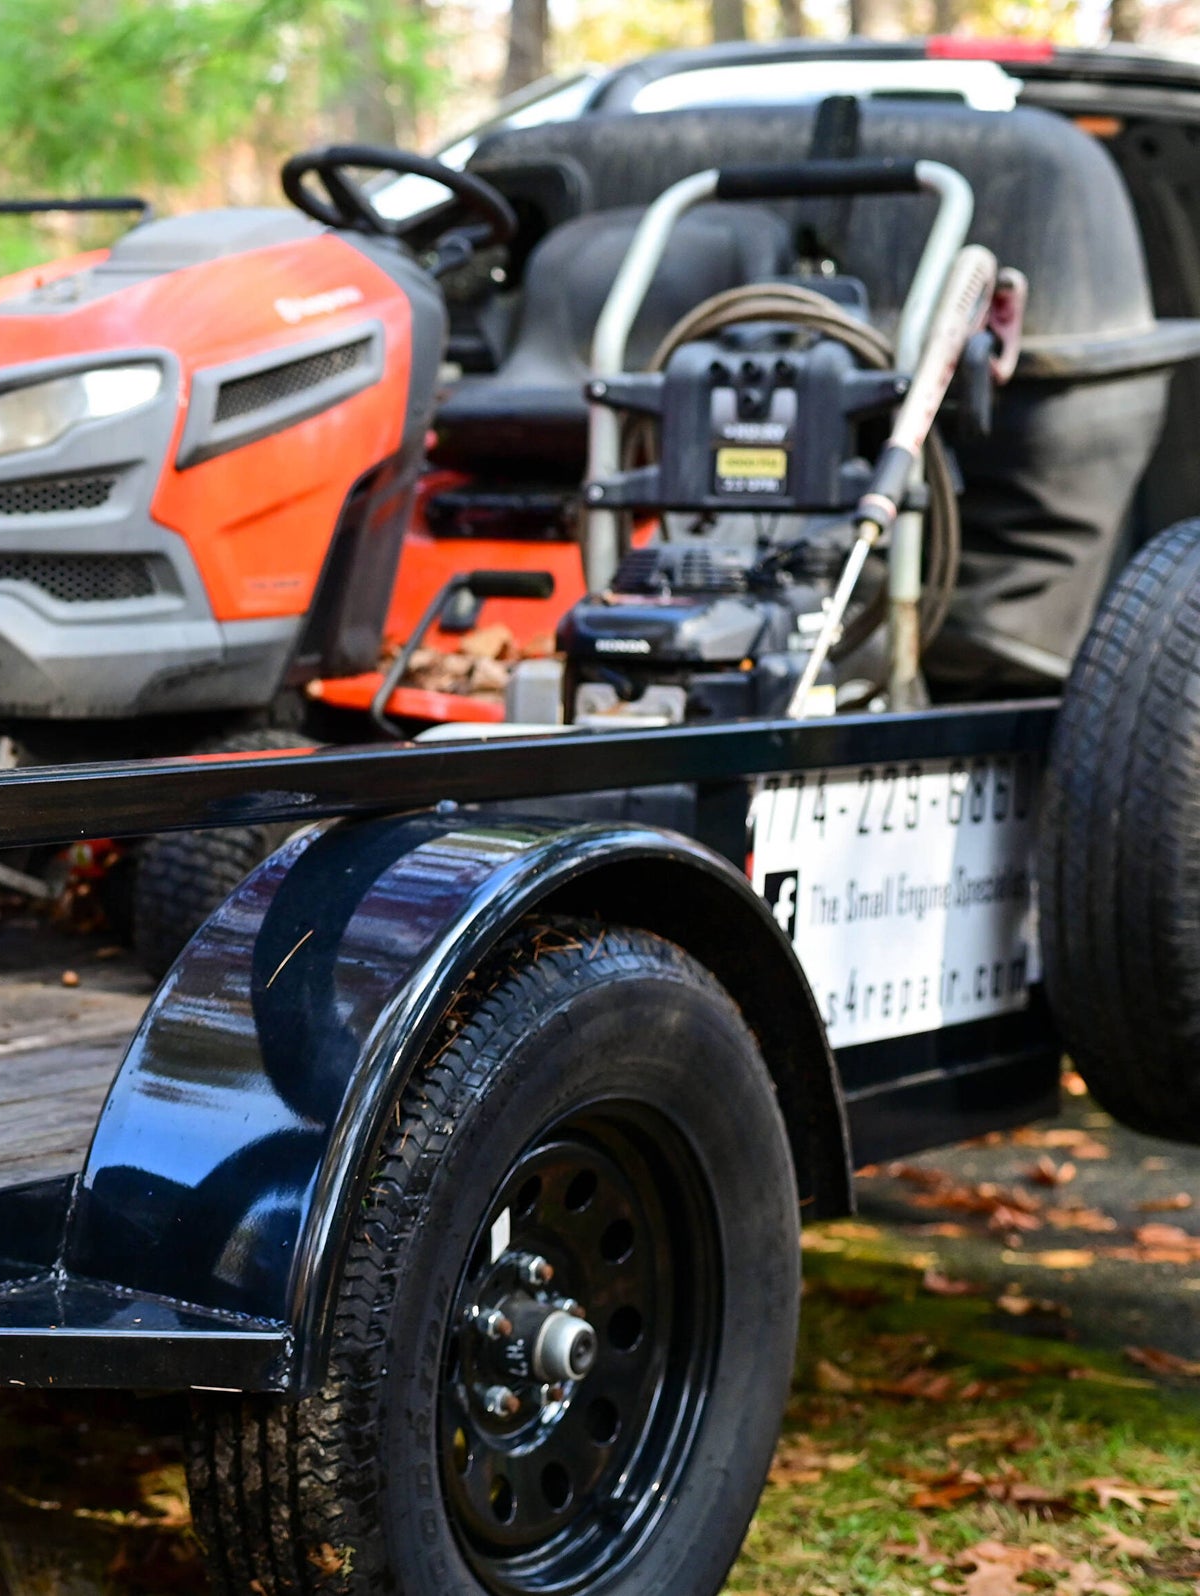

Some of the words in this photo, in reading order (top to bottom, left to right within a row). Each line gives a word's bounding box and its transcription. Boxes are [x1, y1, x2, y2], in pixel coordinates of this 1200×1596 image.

[810, 883, 838, 924] The
[845, 879, 892, 922] Small
[897, 873, 951, 920] Engine
[813, 960, 1027, 1028] s4repair.com
